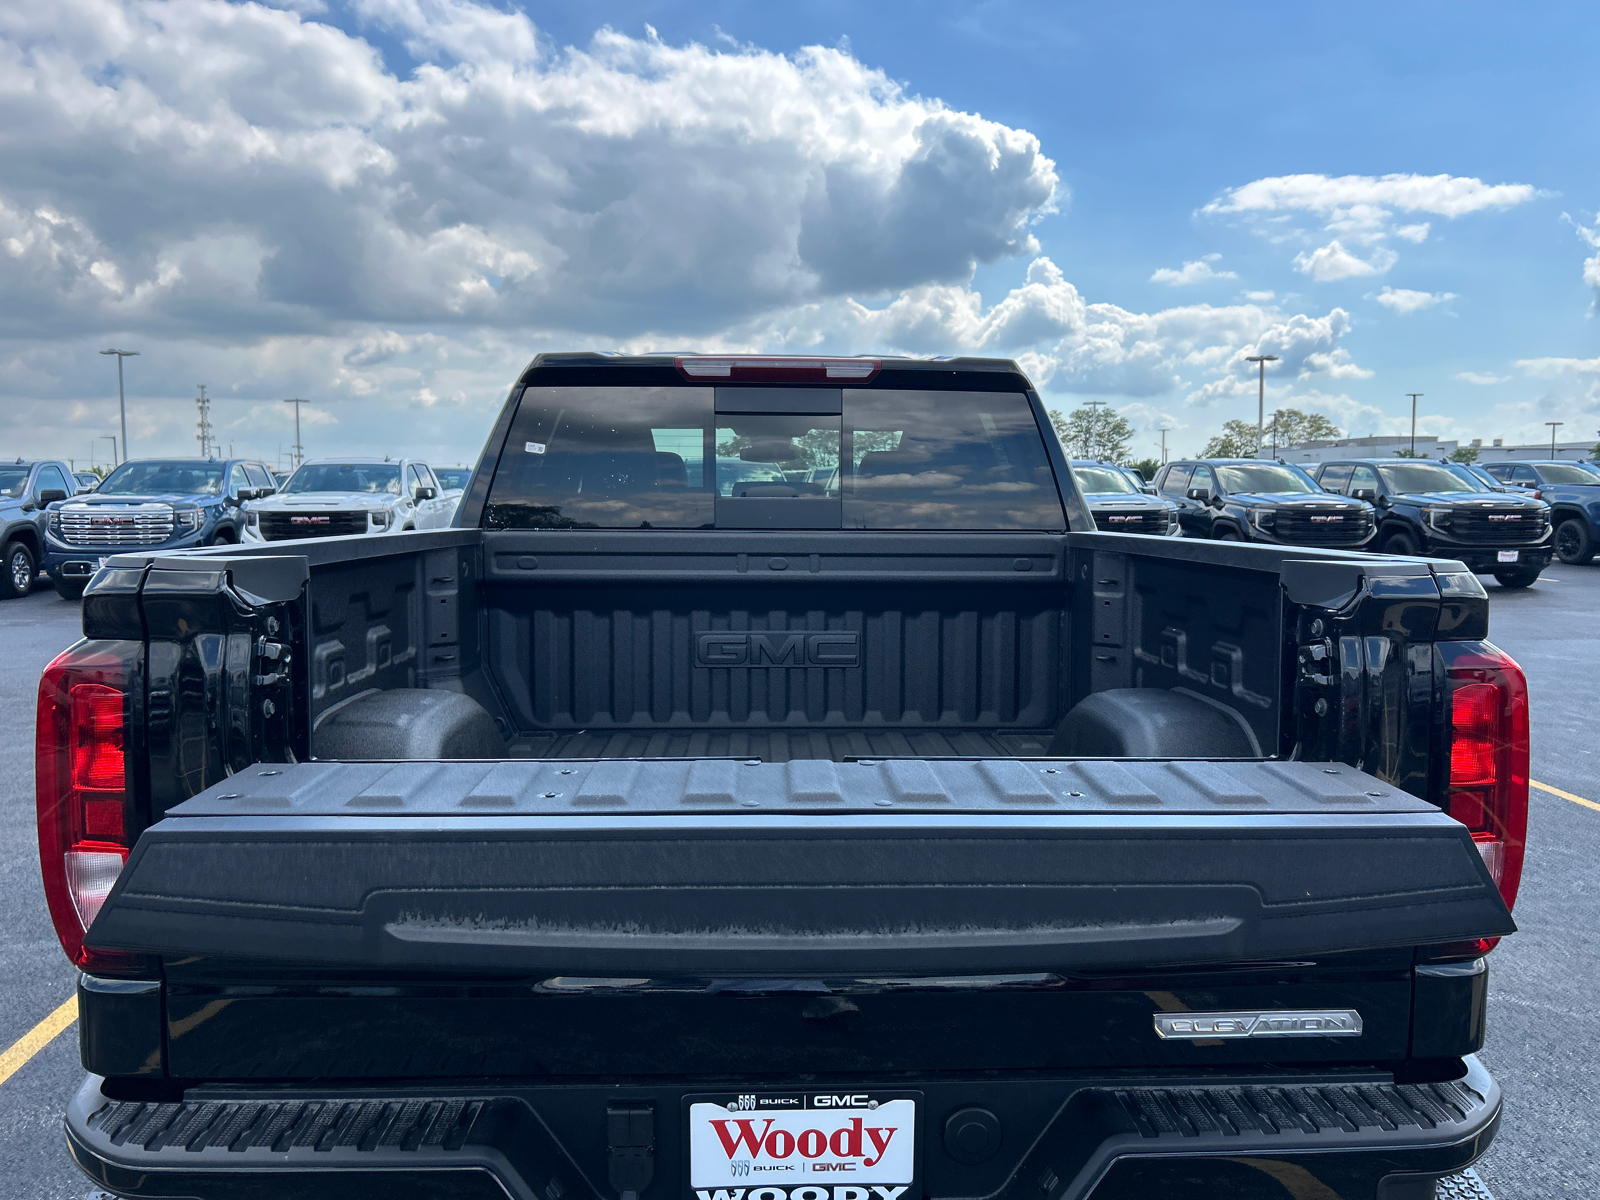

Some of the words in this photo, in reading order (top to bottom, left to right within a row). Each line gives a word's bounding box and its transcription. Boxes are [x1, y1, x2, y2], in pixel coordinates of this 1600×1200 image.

[91, 516, 134, 525] GMC
[290, 516, 330, 525] GMC
[1108, 515, 1143, 523] GMC
[1310, 515, 1344, 523] GMC
[1488, 514, 1522, 522] GMC
[698, 634, 858, 665] GMC
[1170, 1016, 1348, 1033] ELEVATION
[813, 1094, 869, 1107] GMC
[708, 1117, 898, 1168] Woody
[753, 1164, 796, 1172] BUICK
[811, 1162, 857, 1172] GMC
